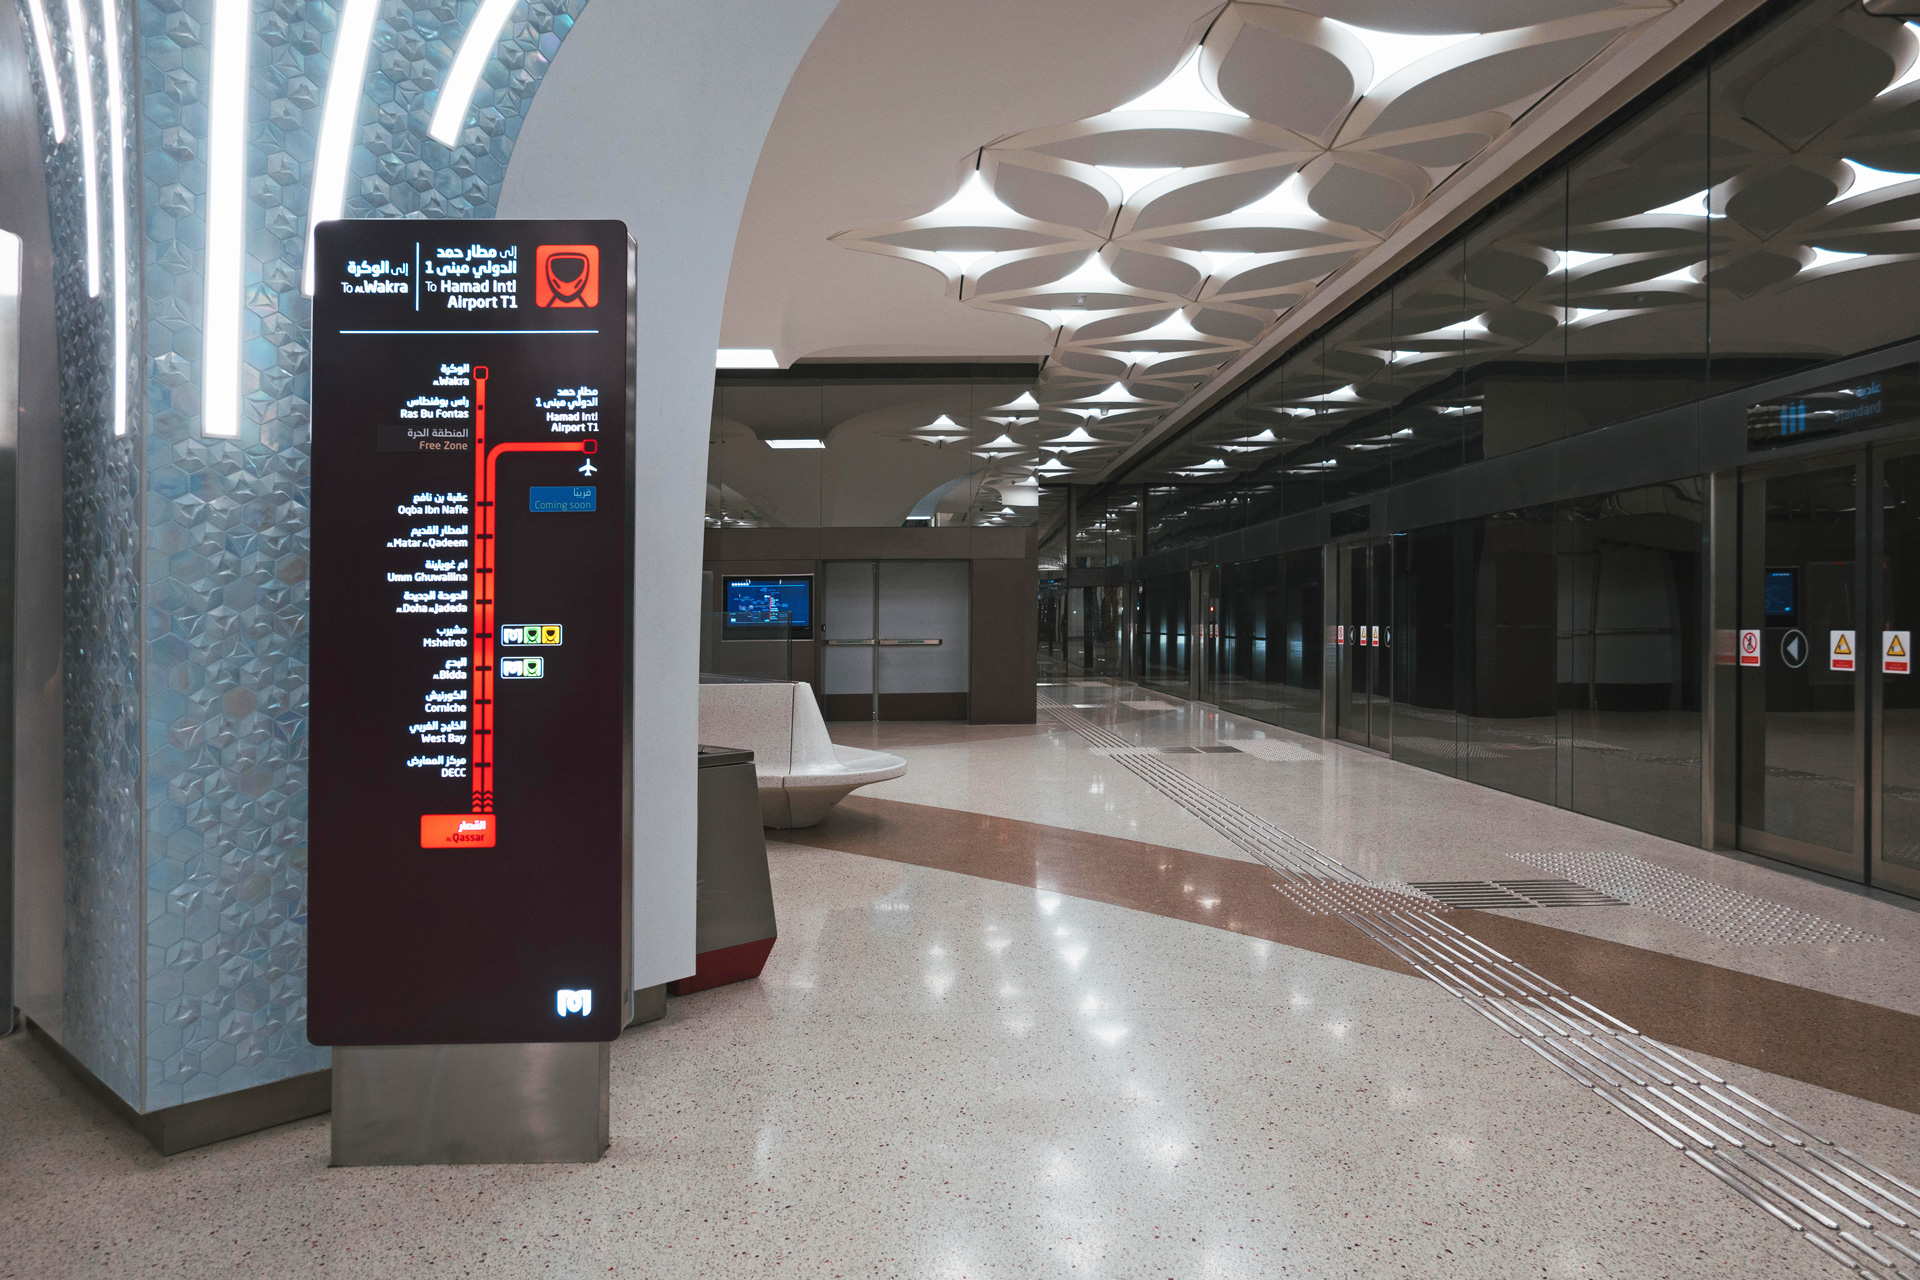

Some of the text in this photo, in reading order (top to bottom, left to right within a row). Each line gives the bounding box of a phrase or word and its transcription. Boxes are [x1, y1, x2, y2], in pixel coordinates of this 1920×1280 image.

[437, 244, 517, 261] إلى مطار حمد
[348, 260, 408, 277] إلى الوكرة
[425, 261, 517, 279] الدولي مبنى 1
[341, 282, 353, 293] To
[425, 280, 516, 293] To Hamad Intl
[447, 295, 518, 311] Airport T1
[441, 363, 469, 374] الوكرة
[557, 386, 598, 398] مطار حمد
[536, 398, 541, 407] 1
[568, 398, 598, 410] الدولي
[400, 409, 469, 418] Ras Bu Fontas
[546, 412, 598, 422] Hamad Intl
[1836, 401, 1881, 422] Standard
[551, 423, 599, 433] Airport T1
[408, 429, 468, 439] المنطقة الحرة
[420, 441, 468, 450] Free Zone
[413, 492, 432, 504] نافع
[398, 505, 468, 516] Oqba Ibn Nafie
[535, 501, 567, 511] Coming
[411, 525, 468, 537] المطار القديم
[387, 572, 468, 582] Umm Ghuwailina
[403, 591, 468, 601] الدوحة الجديدة
[436, 625, 467, 636] مشيرب
[423, 638, 467, 647] Msheireb
[445, 657, 467, 669] البدع
[425, 690, 467, 701] الكورنيش
[425, 703, 466, 712] Corniche
[409, 721, 466, 734] الخليج الغربي
[421, 734, 466, 744] West Bay
[407, 755, 466, 767] مركز المعارض
[441, 768, 466, 777] DECC
[458, 821, 486, 832] القصار
